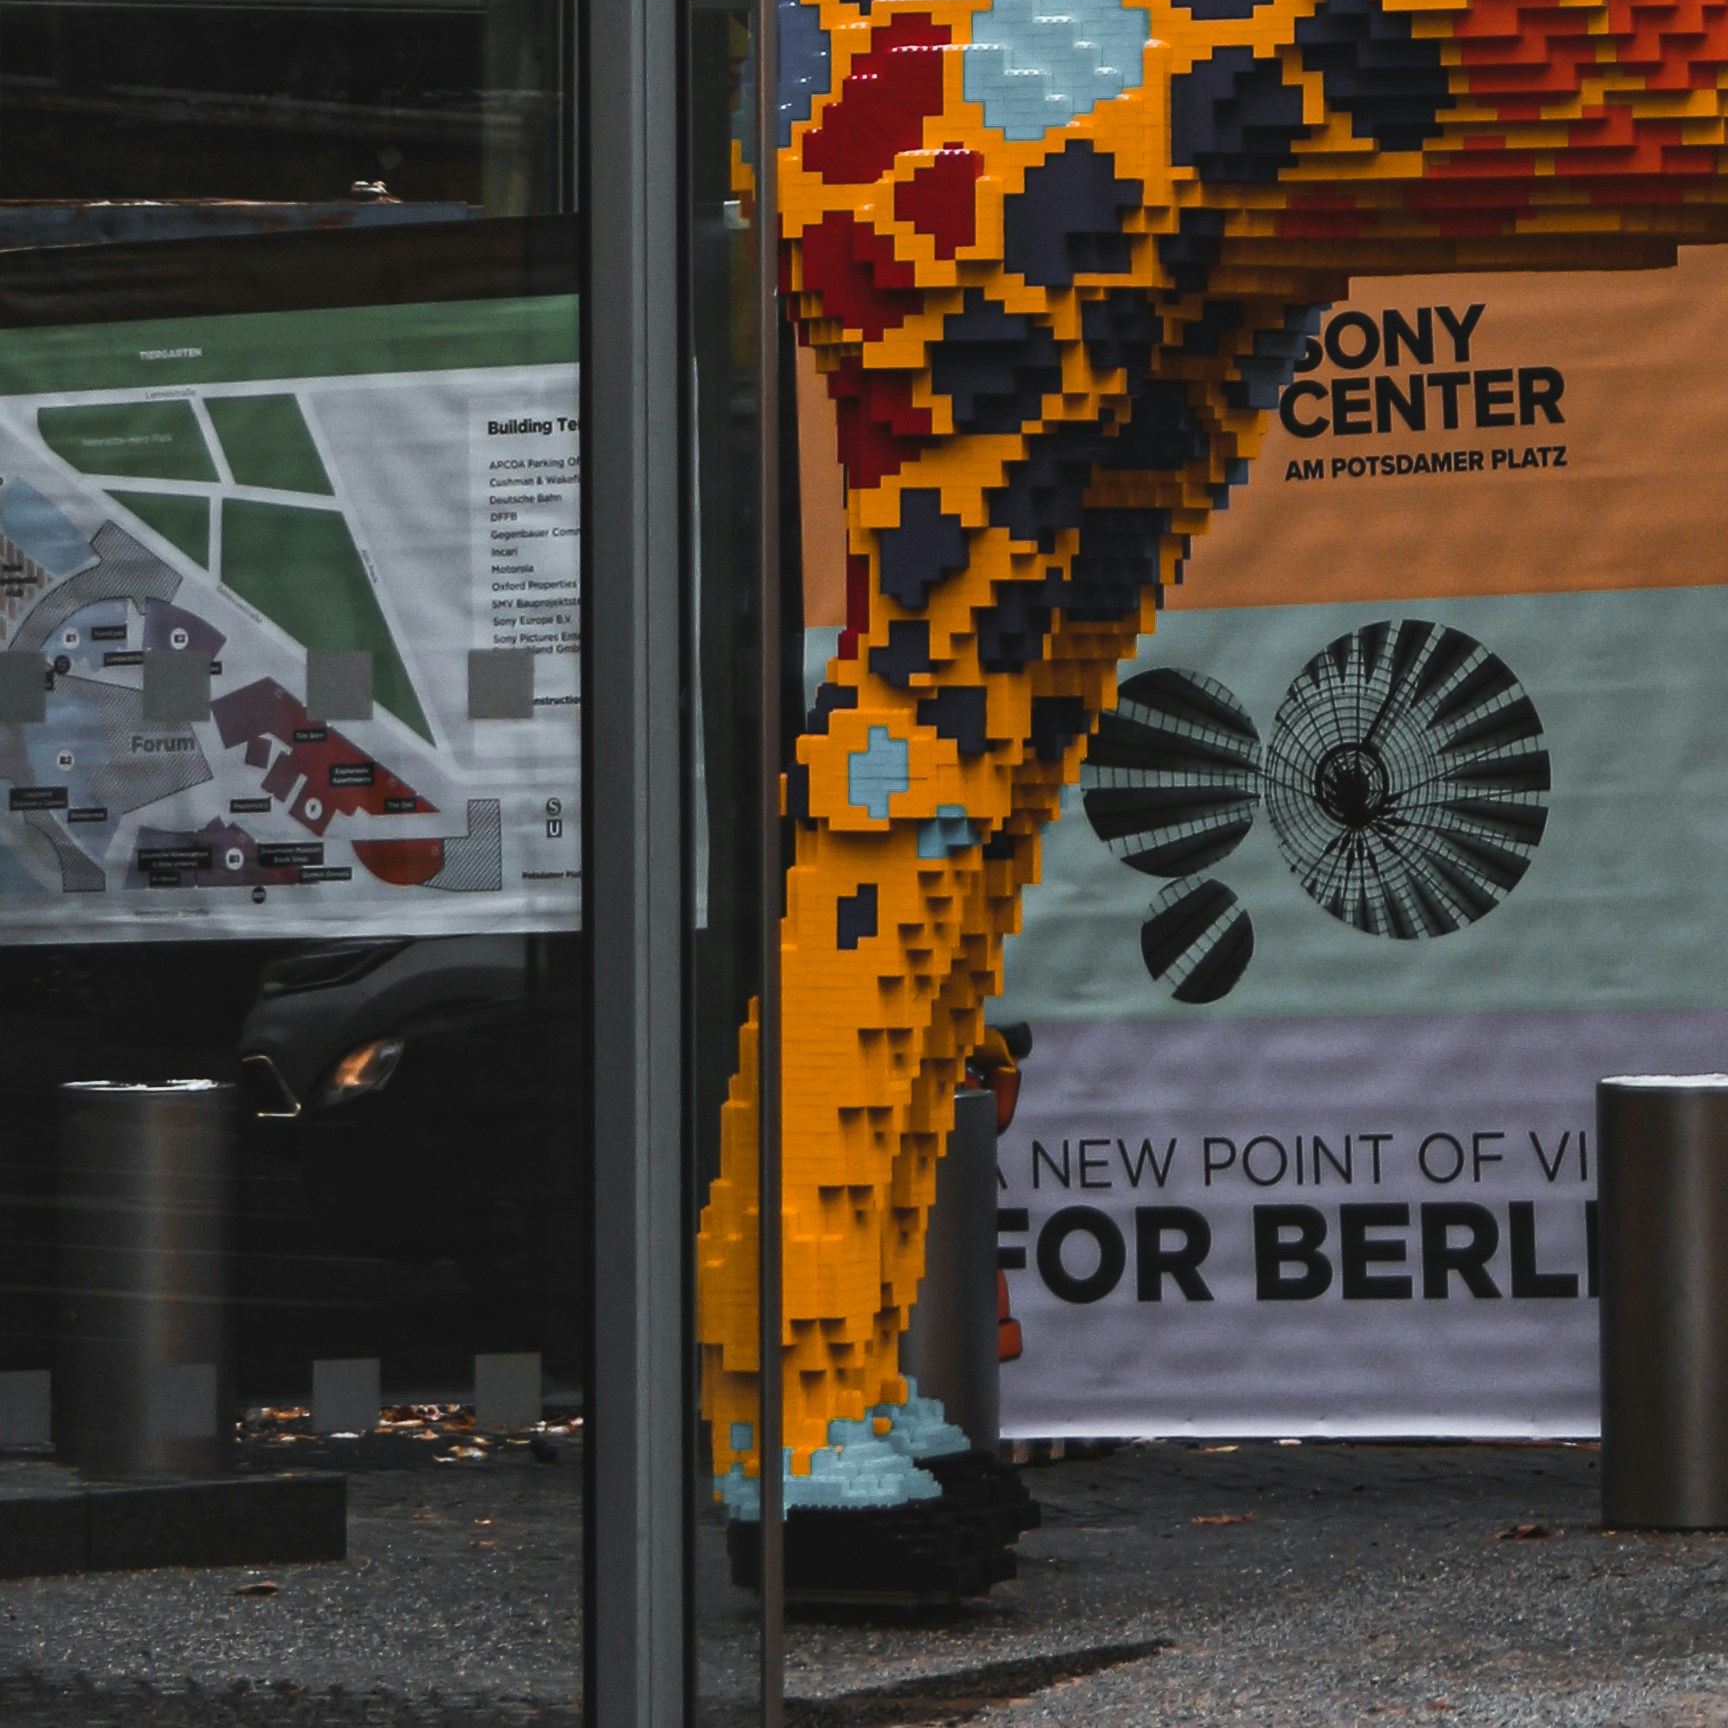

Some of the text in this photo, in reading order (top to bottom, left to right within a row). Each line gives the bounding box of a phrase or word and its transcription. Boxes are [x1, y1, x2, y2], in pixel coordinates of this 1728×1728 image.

[1279, 366, 1567, 439] CENTER
[487, 418, 553, 436] Building
[1285, 446, 1569, 482] AM POTSDAMER PLATZ
[131, 735, 196, 754] Forum
[547, 798, 560, 814] S
[548, 820, 561, 836] U
[1032, 1137, 1178, 1190] NEW
[1203, 1133, 1395, 1187] POINT
[1418, 1131, 1506, 1185] OF
[998, 1204, 1215, 1305] FOR
